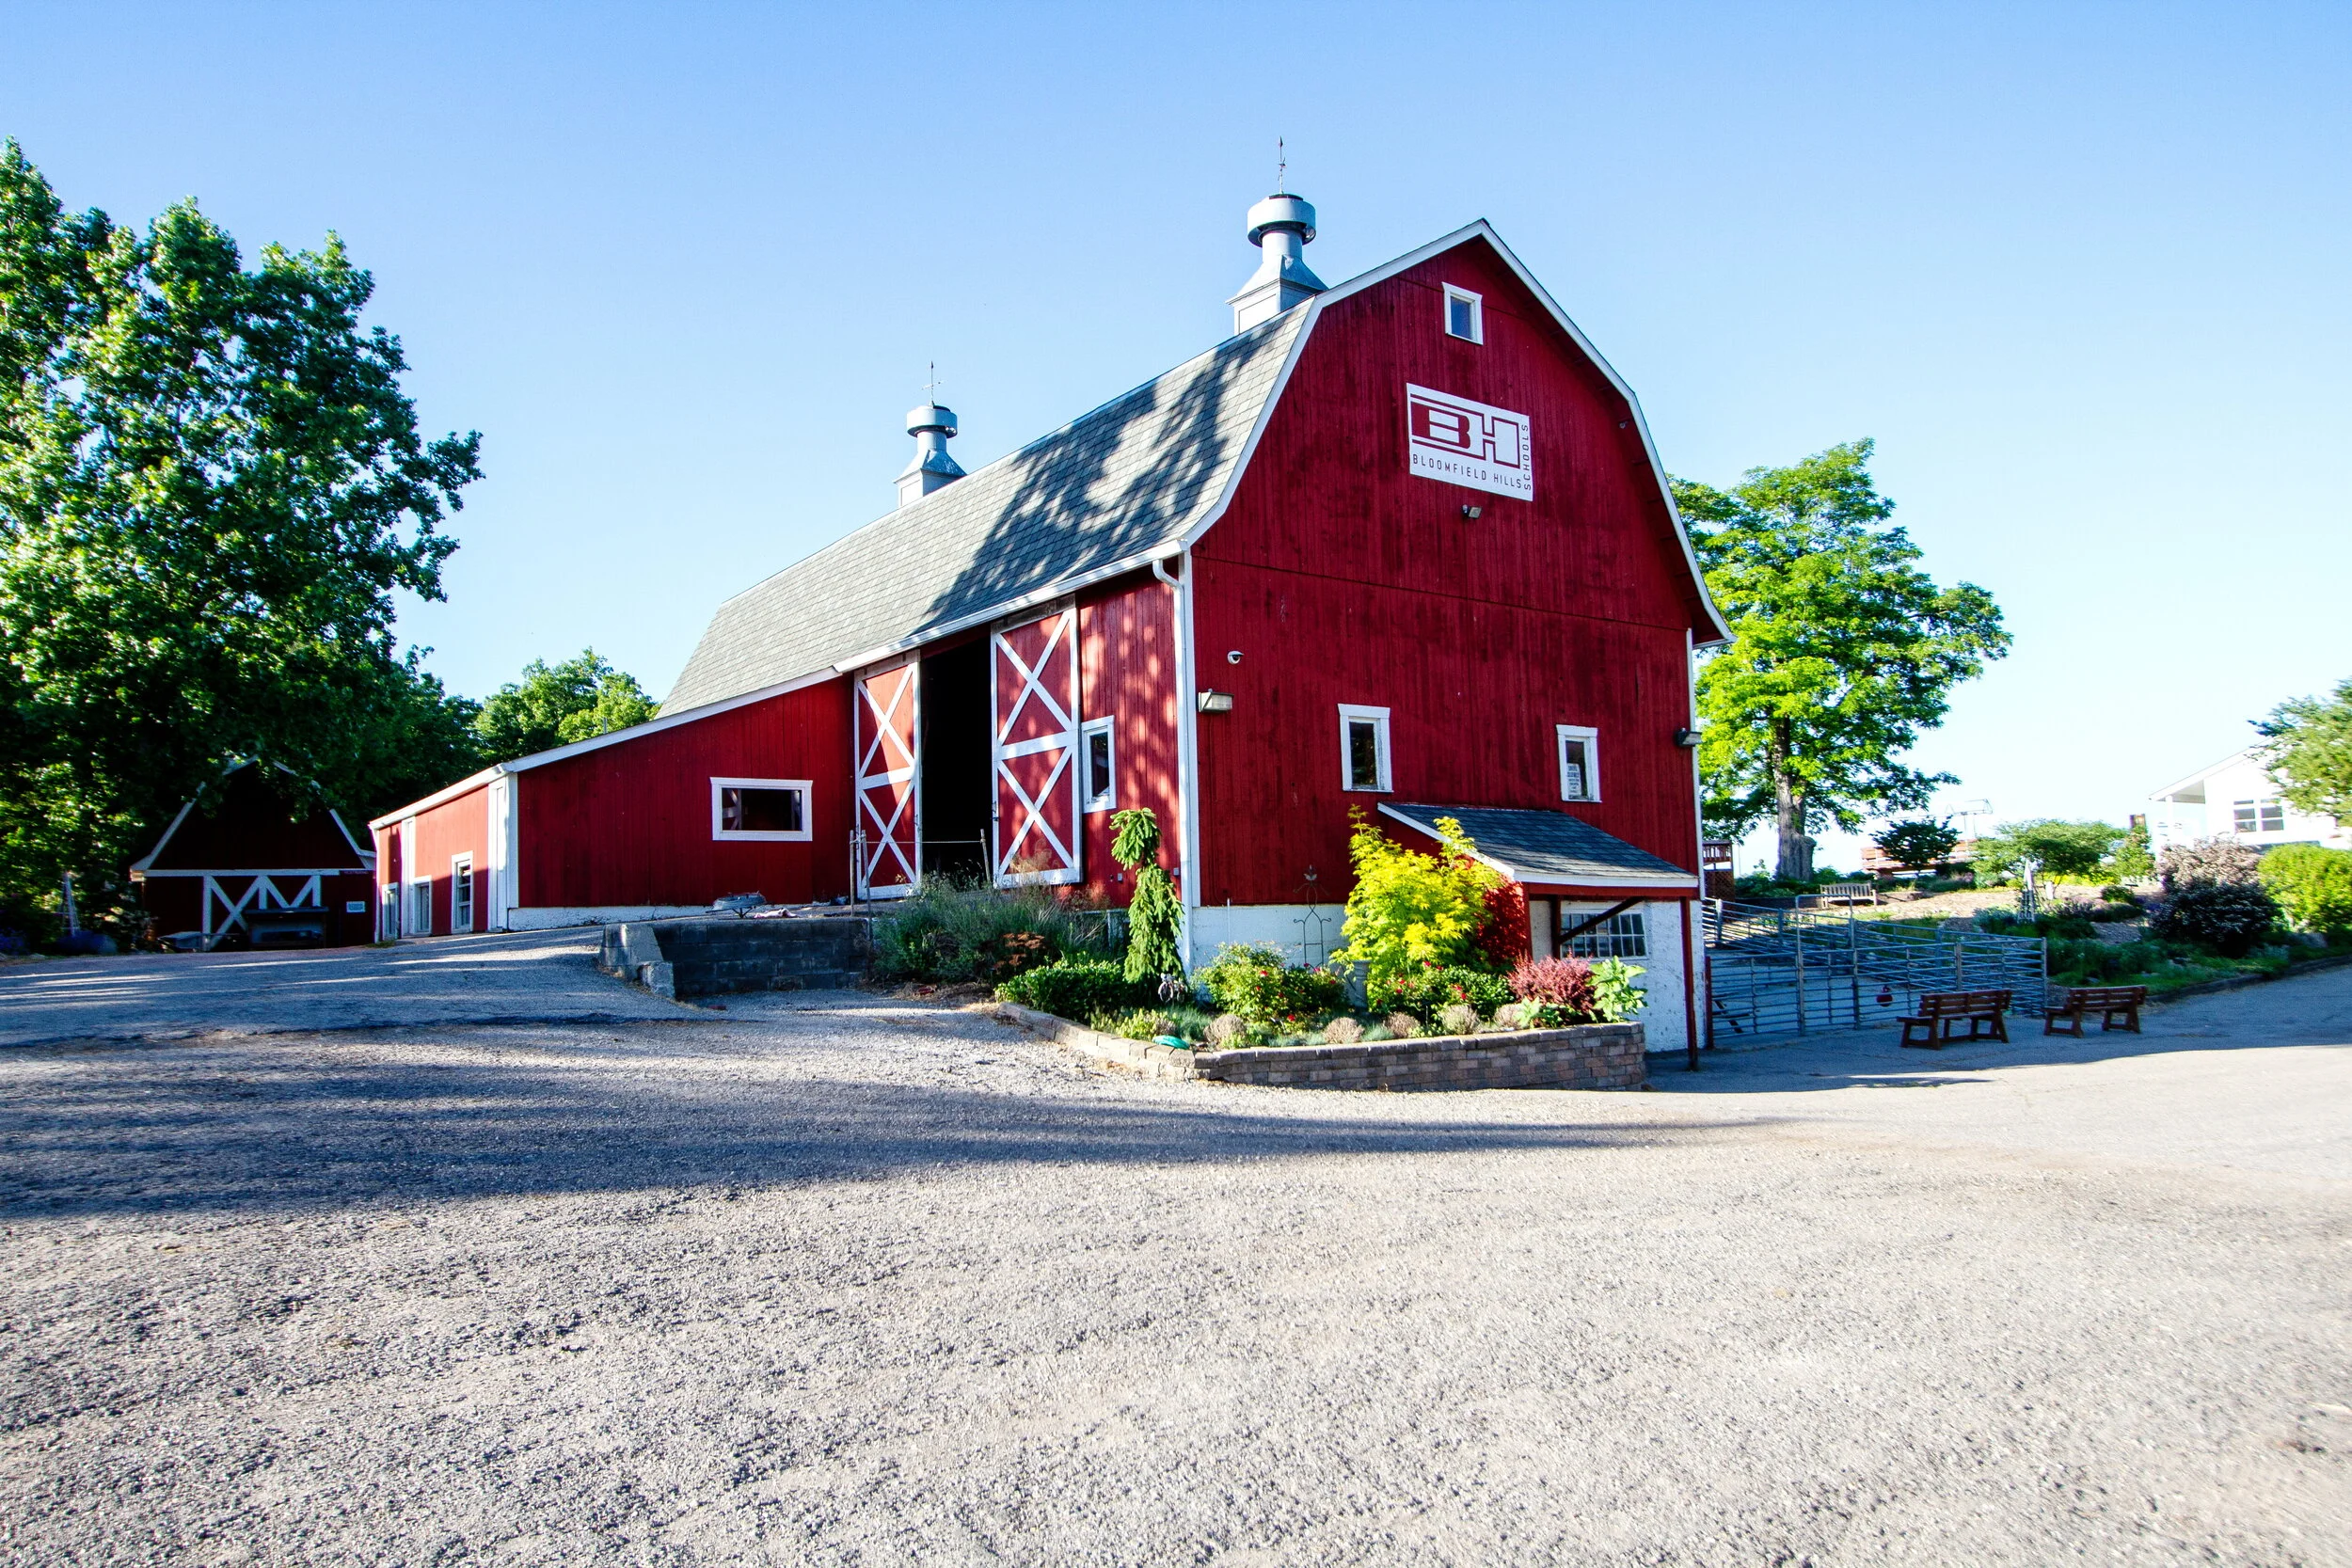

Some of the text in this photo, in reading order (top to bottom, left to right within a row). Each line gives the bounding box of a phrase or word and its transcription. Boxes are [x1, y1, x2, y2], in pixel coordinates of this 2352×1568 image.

[1410, 393, 1520, 468] BH
[1521, 424, 1532, 491] SCHOOLS
[1412, 454, 1521, 489] BLOOMFIELD HILLS
